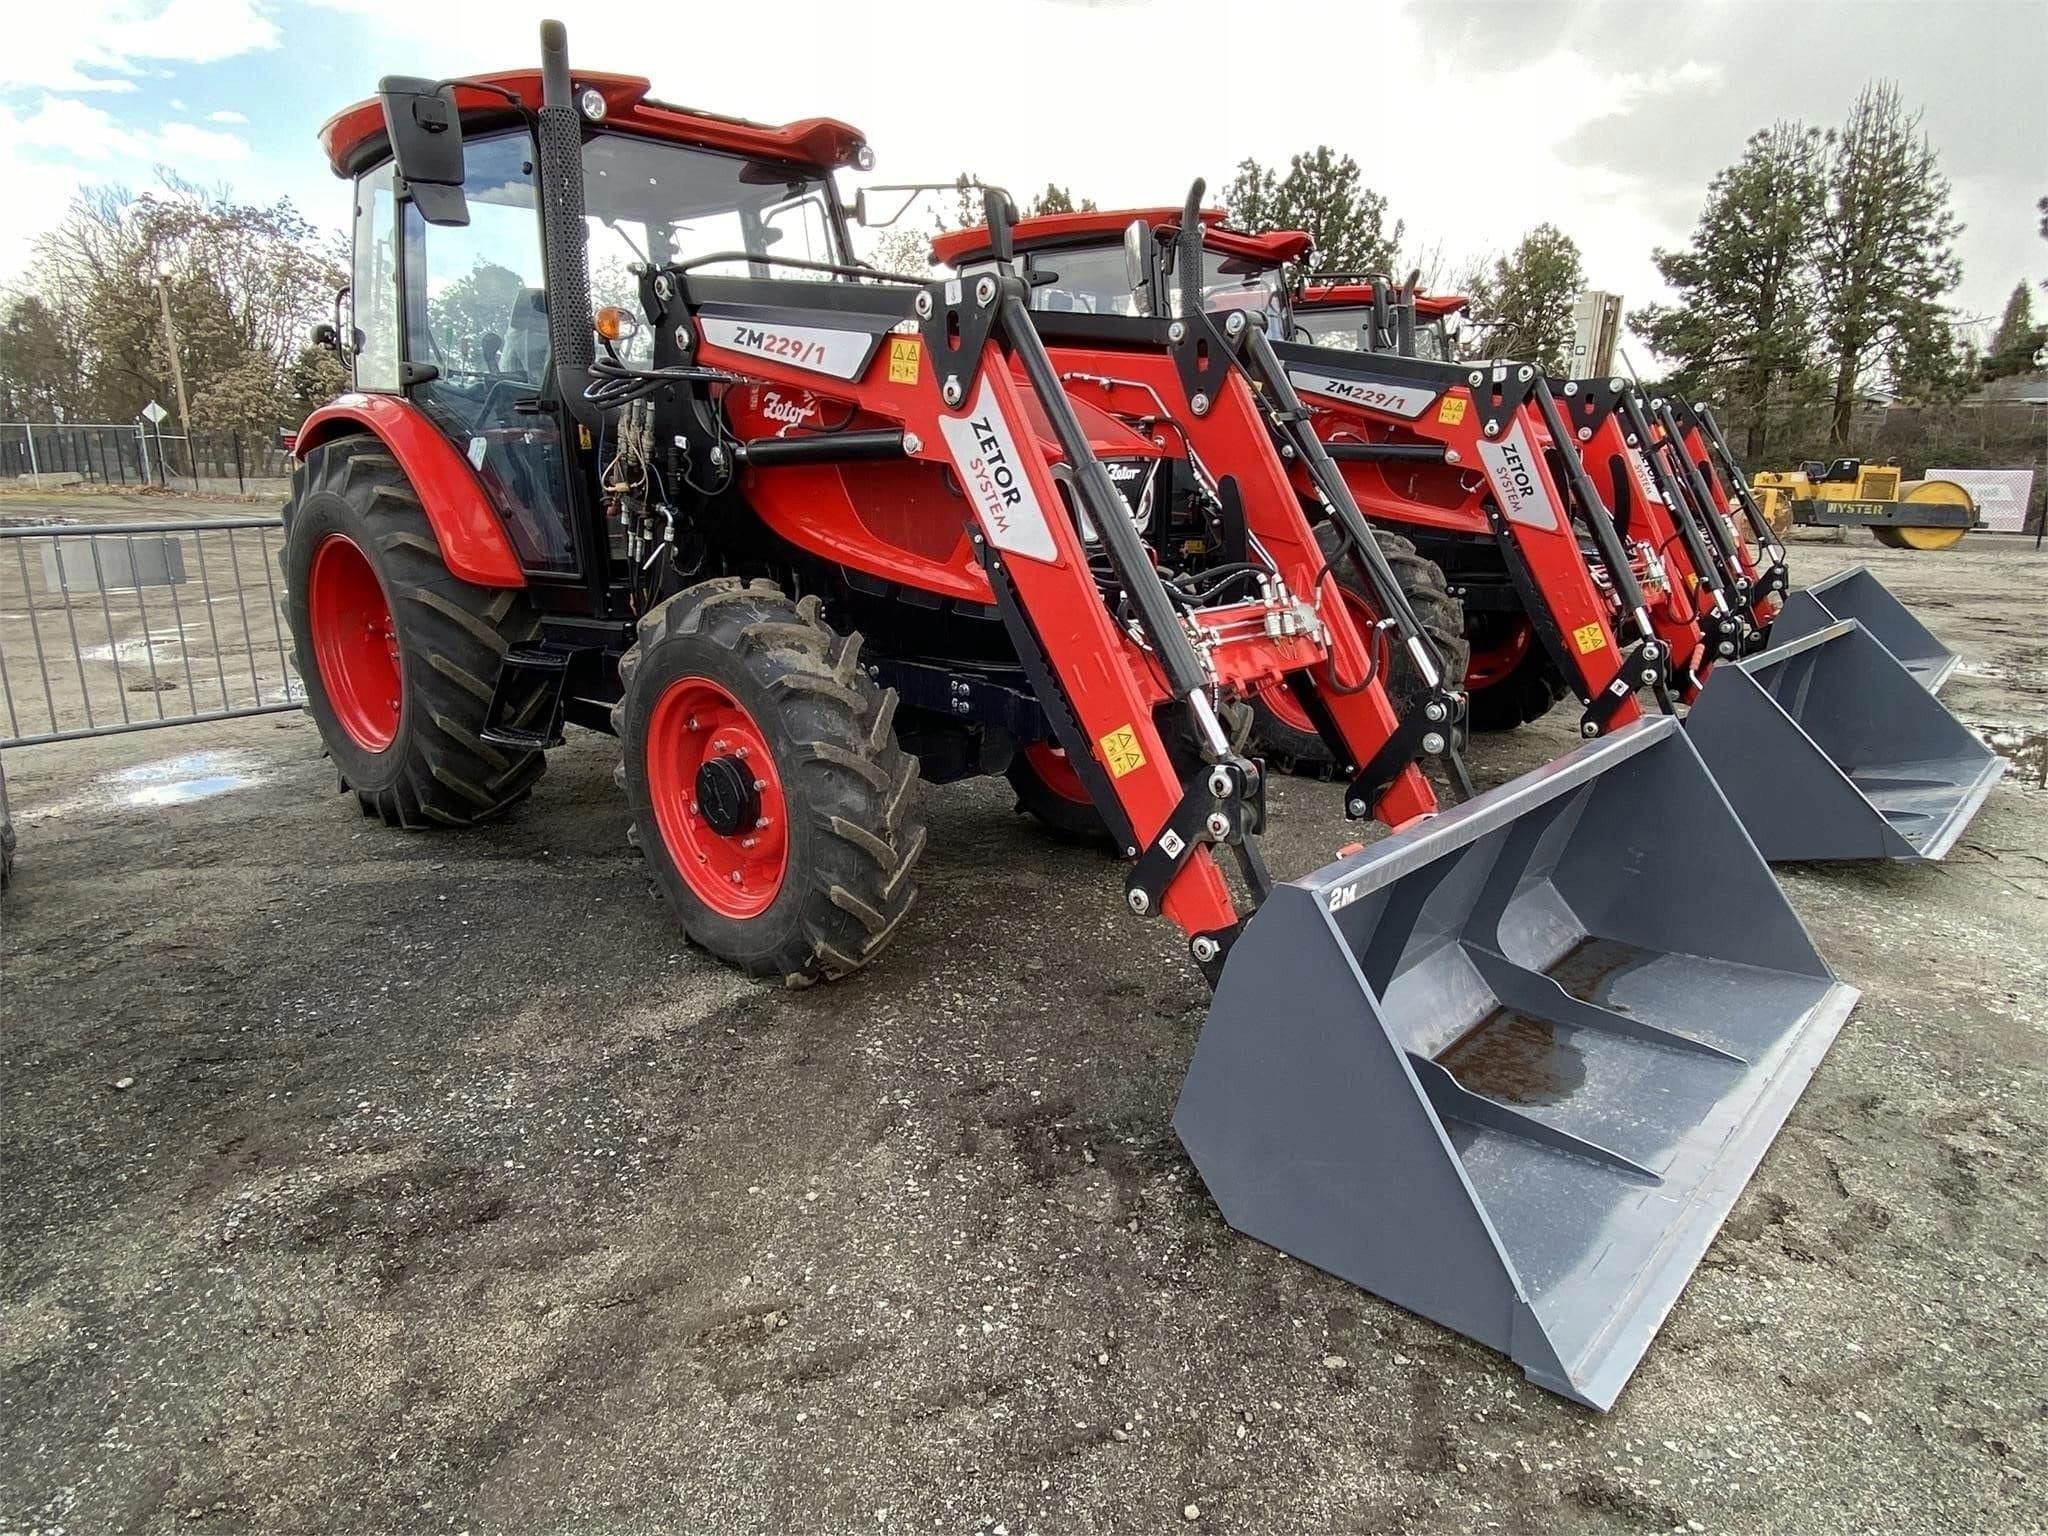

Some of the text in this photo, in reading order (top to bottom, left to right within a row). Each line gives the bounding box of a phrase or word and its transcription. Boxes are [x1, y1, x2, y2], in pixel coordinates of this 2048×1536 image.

[733, 326, 826, 365] ZM229/1
[1325, 380, 1406, 410] ZM229/1
[970, 416, 1022, 508] ZETOR
[1501, 443, 1534, 498] ZETOR
[970, 457, 1010, 534] SYSTEM
[1496, 466, 1523, 513] SYSTEM
